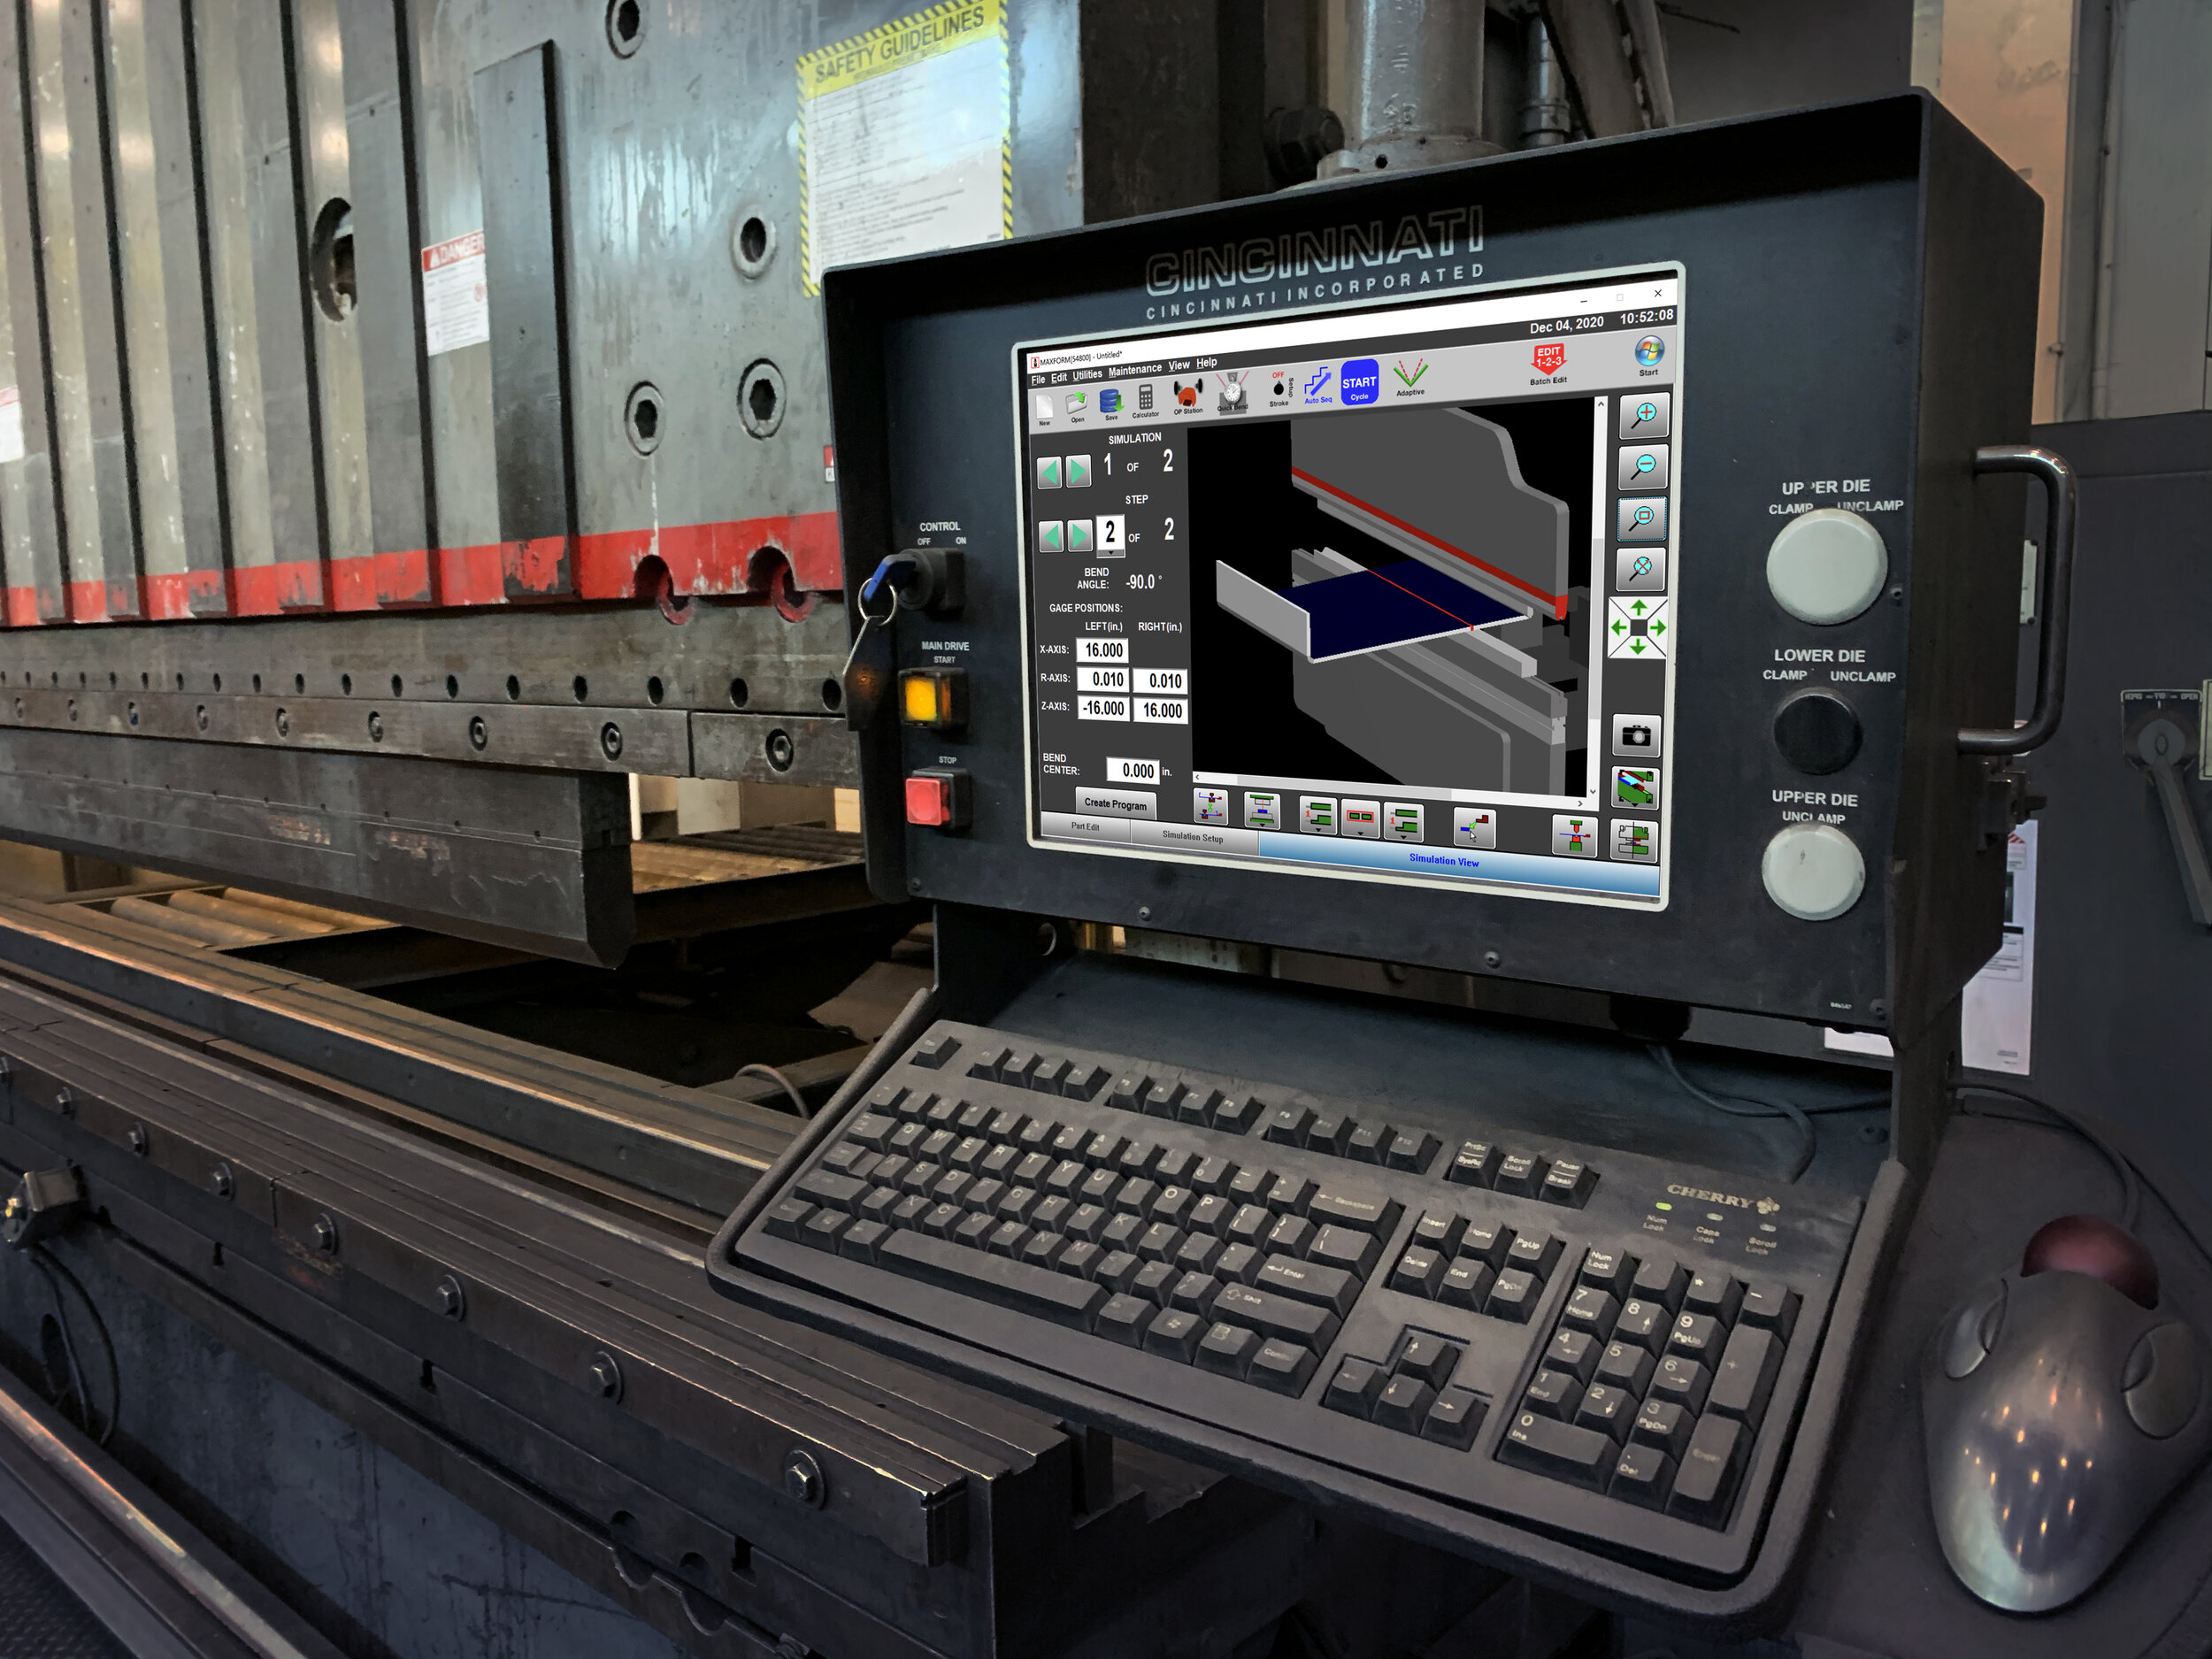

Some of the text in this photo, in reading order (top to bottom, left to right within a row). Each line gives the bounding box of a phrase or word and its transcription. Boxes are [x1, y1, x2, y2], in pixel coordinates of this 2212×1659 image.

[815, 46, 875, 84] SAFETY
[880, 6, 985, 61] GUIDELINES
[441, 234, 485, 263] DANGER
[1146, 204, 1484, 297] CINCINNATI
[1147, 263, 1484, 320] CINCINNATI INCORPORATED
[1530, 309, 1674, 334] Dec 04, 2020 10:52:08
[1538, 346, 1561, 357] EDIT
[1536, 357, 1562, 367] 1-2-3
[1032, 357, 1217, 386] File Edit Utilities Maintenance View Help
[1342, 376, 1377, 389] START
[1350, 393, 1369, 402] Cycle
[1396, 388, 1425, 397] Adaptive
[1109, 432, 1162, 444] SIMULATION
[1104, 449, 1173, 475] 1 OF 2
[1782, 479, 1871, 495] UPER DIE
[1125, 495, 1148, 504] STEP
[1769, 503, 1814, 515] CLAMP
[1837, 500, 1904, 512] UNCLAMP
[919, 521, 961, 532] CONTROL
[1106, 518, 1174, 542] 2 OF 2
[1084, 567, 1110, 577] BEND
[1077, 580, 1110, 589] ANGLE:
[1049, 603, 1124, 613] GAGE POSITIONS:
[1085, 622, 1123, 632] LEFT(in.)
[1138, 622, 1183, 633] RIGHT(in.)
[922, 641, 970, 651] MAIN DRIVE
[1040, 642, 1123, 657] X-AXIS: 16.000
[1774, 649, 1866, 663] LOWER DIE
[1041, 672, 1182, 688] R-AXIS: 0.010 0.010
[1763, 670, 1808, 680] CLAMP
[1830, 671, 1896, 683] UNCLAMP
[1041, 700, 1183, 718] Z-AXIS: -16.000 16.000
[938, 756, 957, 764] STOP
[1043, 753, 1067, 763] BEND
[1043, 765, 1080, 776] CENTER:
[1123, 763, 1172, 779] 0.000 in.
[1085, 797, 1148, 811] Create Program
[1772, 790, 1858, 807] UPPER DIE
[1071, 821, 1100, 832] Part Edit
[1163, 831, 1201, 841] Simulation
[1409, 852, 1479, 868] Simulation View
[962, 1140, 975, 1149] E
[1026, 1153, 1041, 1164] T
[916, 1164, 926, 1173] S
[1061, 1162, 1072, 1172] Y
[1094, 1171, 1106, 1181] U
[1164, 1187, 1179, 1199] O
[1667, 1183, 1755, 1210] CHERRY
[1044, 1198, 1058, 1208] H
[1201, 1197, 1215, 1208] P
[938, 1205, 951, 1215] C
[1079, 1207, 1092, 1216] J
[1115, 1216, 1129, 1226] K
[1150, 1225, 1160, 1235] L
[1517, 1238, 1540, 1250] PgUp
[1591, 1250, 1613, 1262] Num
[1587, 1258, 1609, 1271] Lock
[1450, 1269, 1469, 1279] End
[1575, 1288, 1588, 1301] 7
[1567, 1305, 1593, 1318] Home
[1627, 1302, 1640, 1315] 8
[1680, 1315, 1693, 1327] 9
[1558, 1333, 1571, 1344] 4
[1609, 1345, 1622, 1357] 5
[1664, 1359, 1678, 1371] 6
[1591, 1387, 1605, 1400] 2
[1647, 1402, 1660, 1414] 3
[1521, 1414, 1533, 1427] 0
[1639, 1417, 1668, 1431] PgDn
